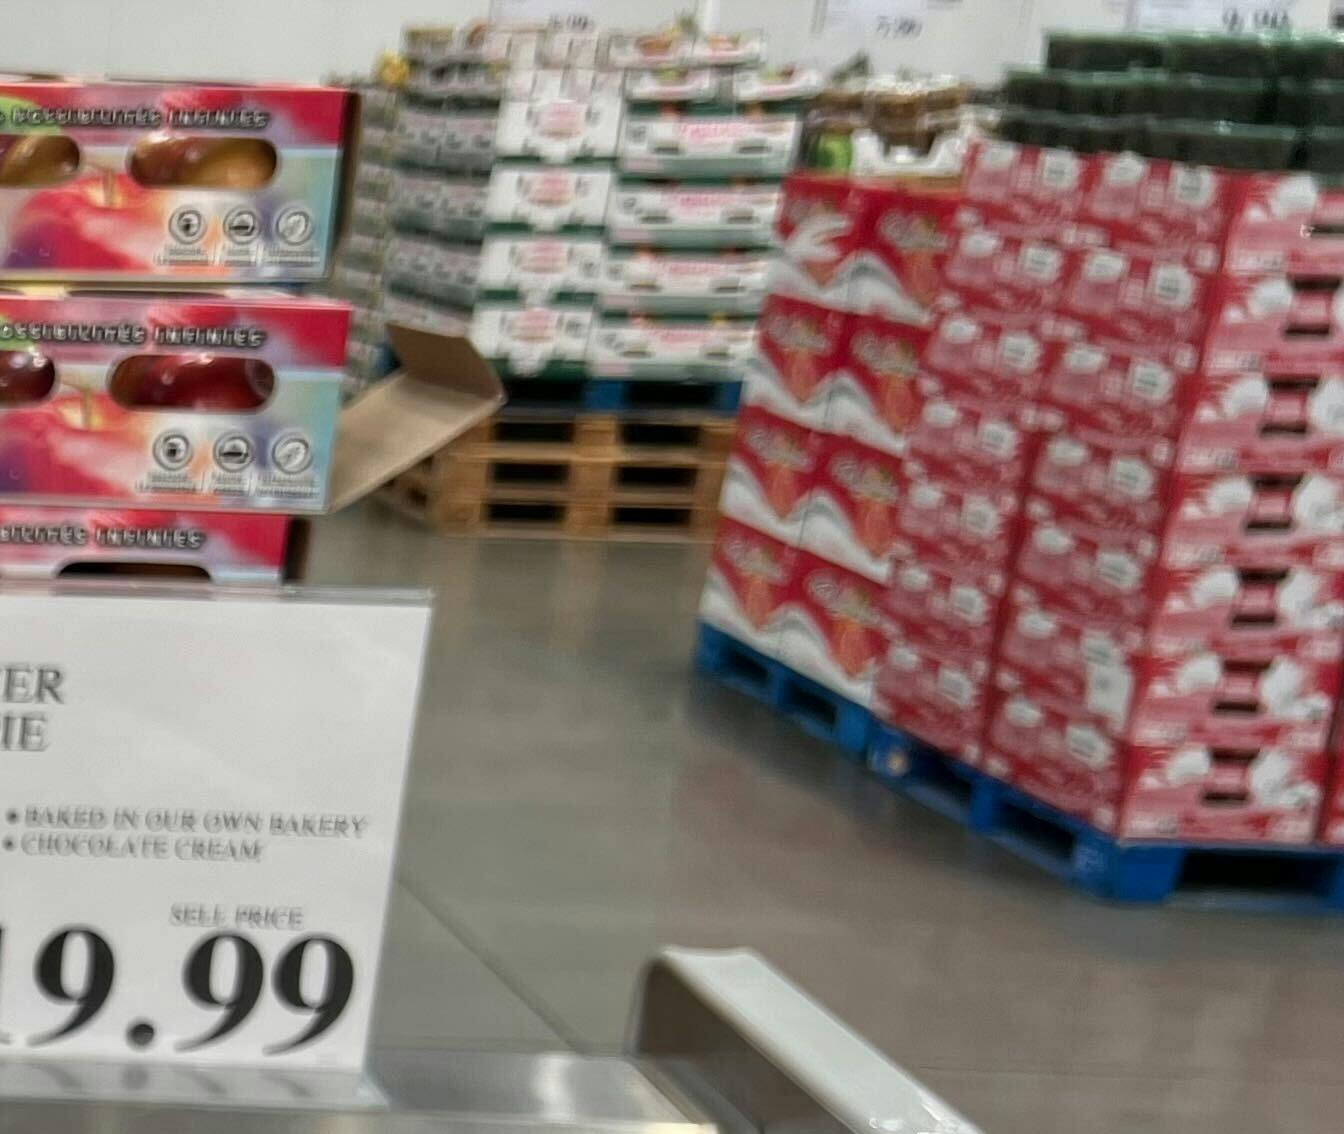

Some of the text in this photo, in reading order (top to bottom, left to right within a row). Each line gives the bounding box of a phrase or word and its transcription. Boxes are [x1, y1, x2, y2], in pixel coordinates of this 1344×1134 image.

[24, 805, 368, 838] BAKED IN OUR OWN BAKERY
[20, 834, 263, 863] CHOCOLATE CREAM
[168, 903, 305, 930] SELL PRICE
